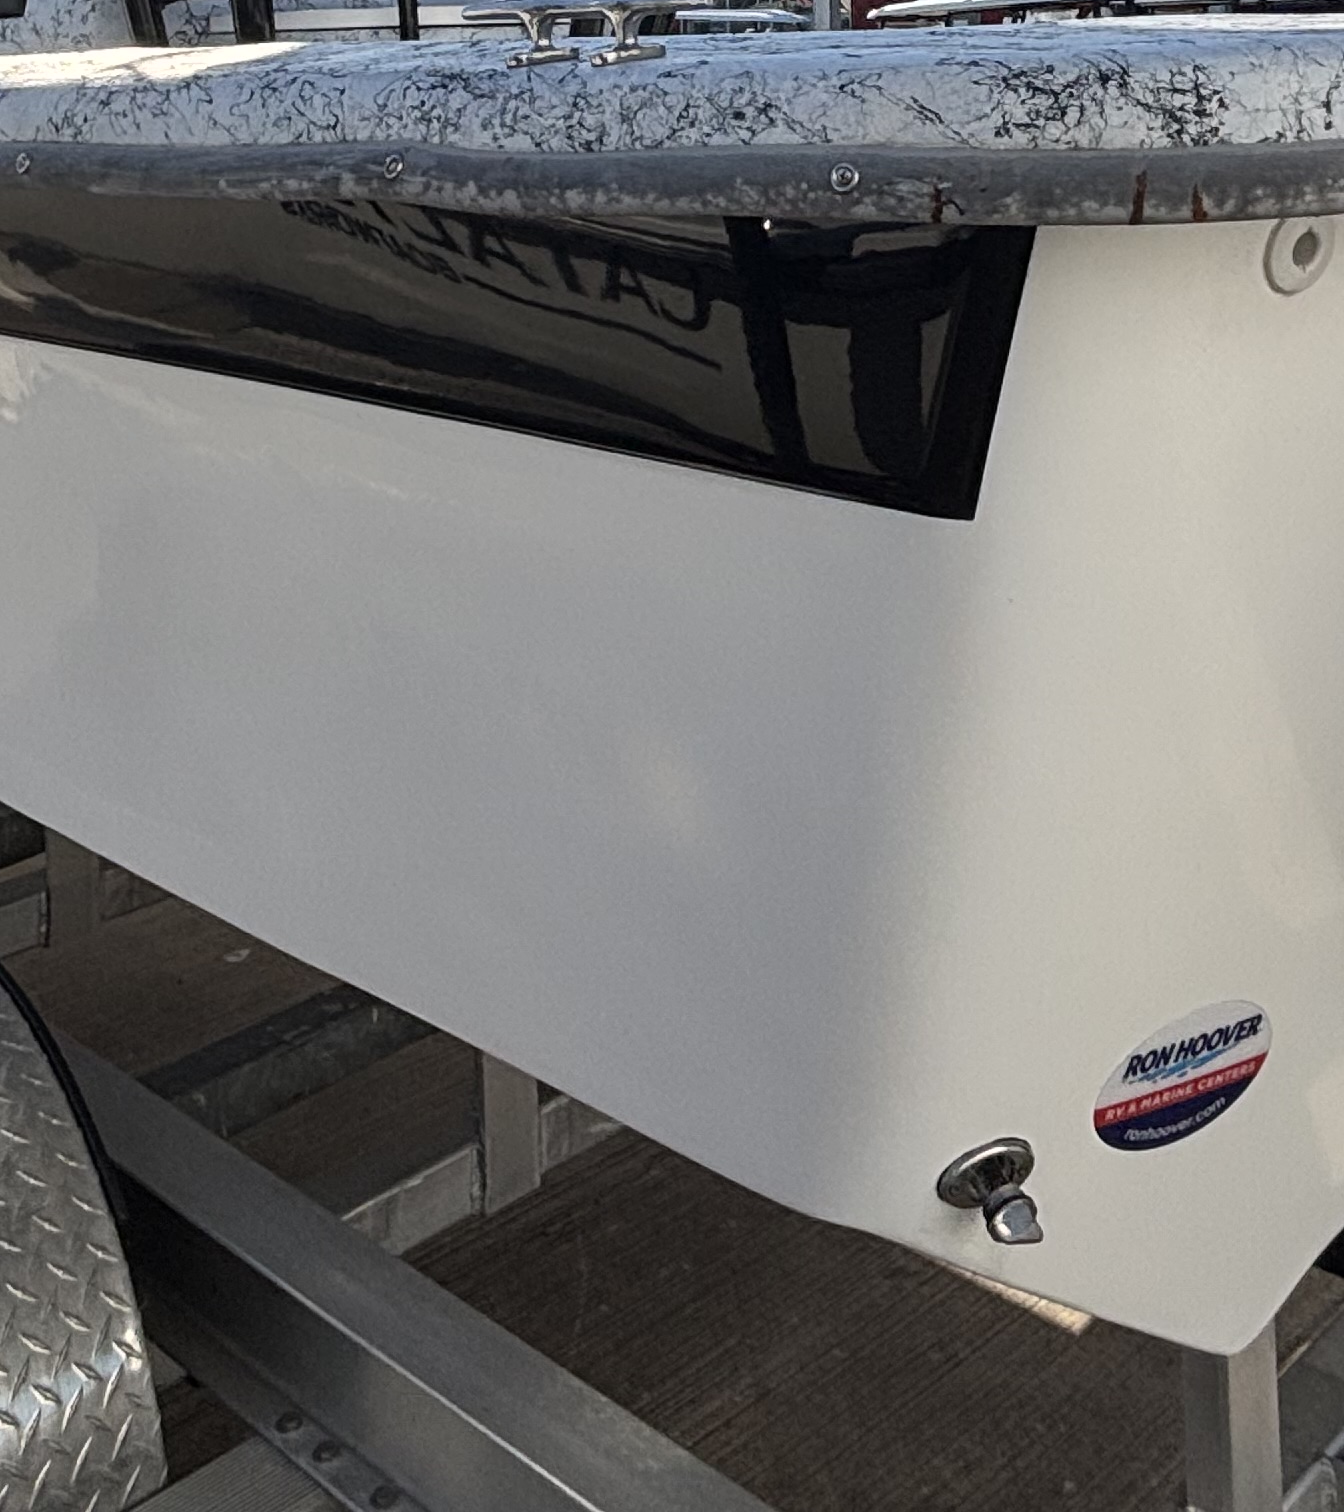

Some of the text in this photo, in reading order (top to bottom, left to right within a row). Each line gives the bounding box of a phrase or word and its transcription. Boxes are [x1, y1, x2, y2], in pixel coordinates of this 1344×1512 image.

[1123, 1013, 1263, 1079] RON HOOVER
[1105, 1108, 1124, 1121] RV
[1140, 1084, 1194, 1110] MARINE
[1197, 1060, 1257, 1090] CENTERS
[1123, 1095, 1227, 1142] ronhoover.com
